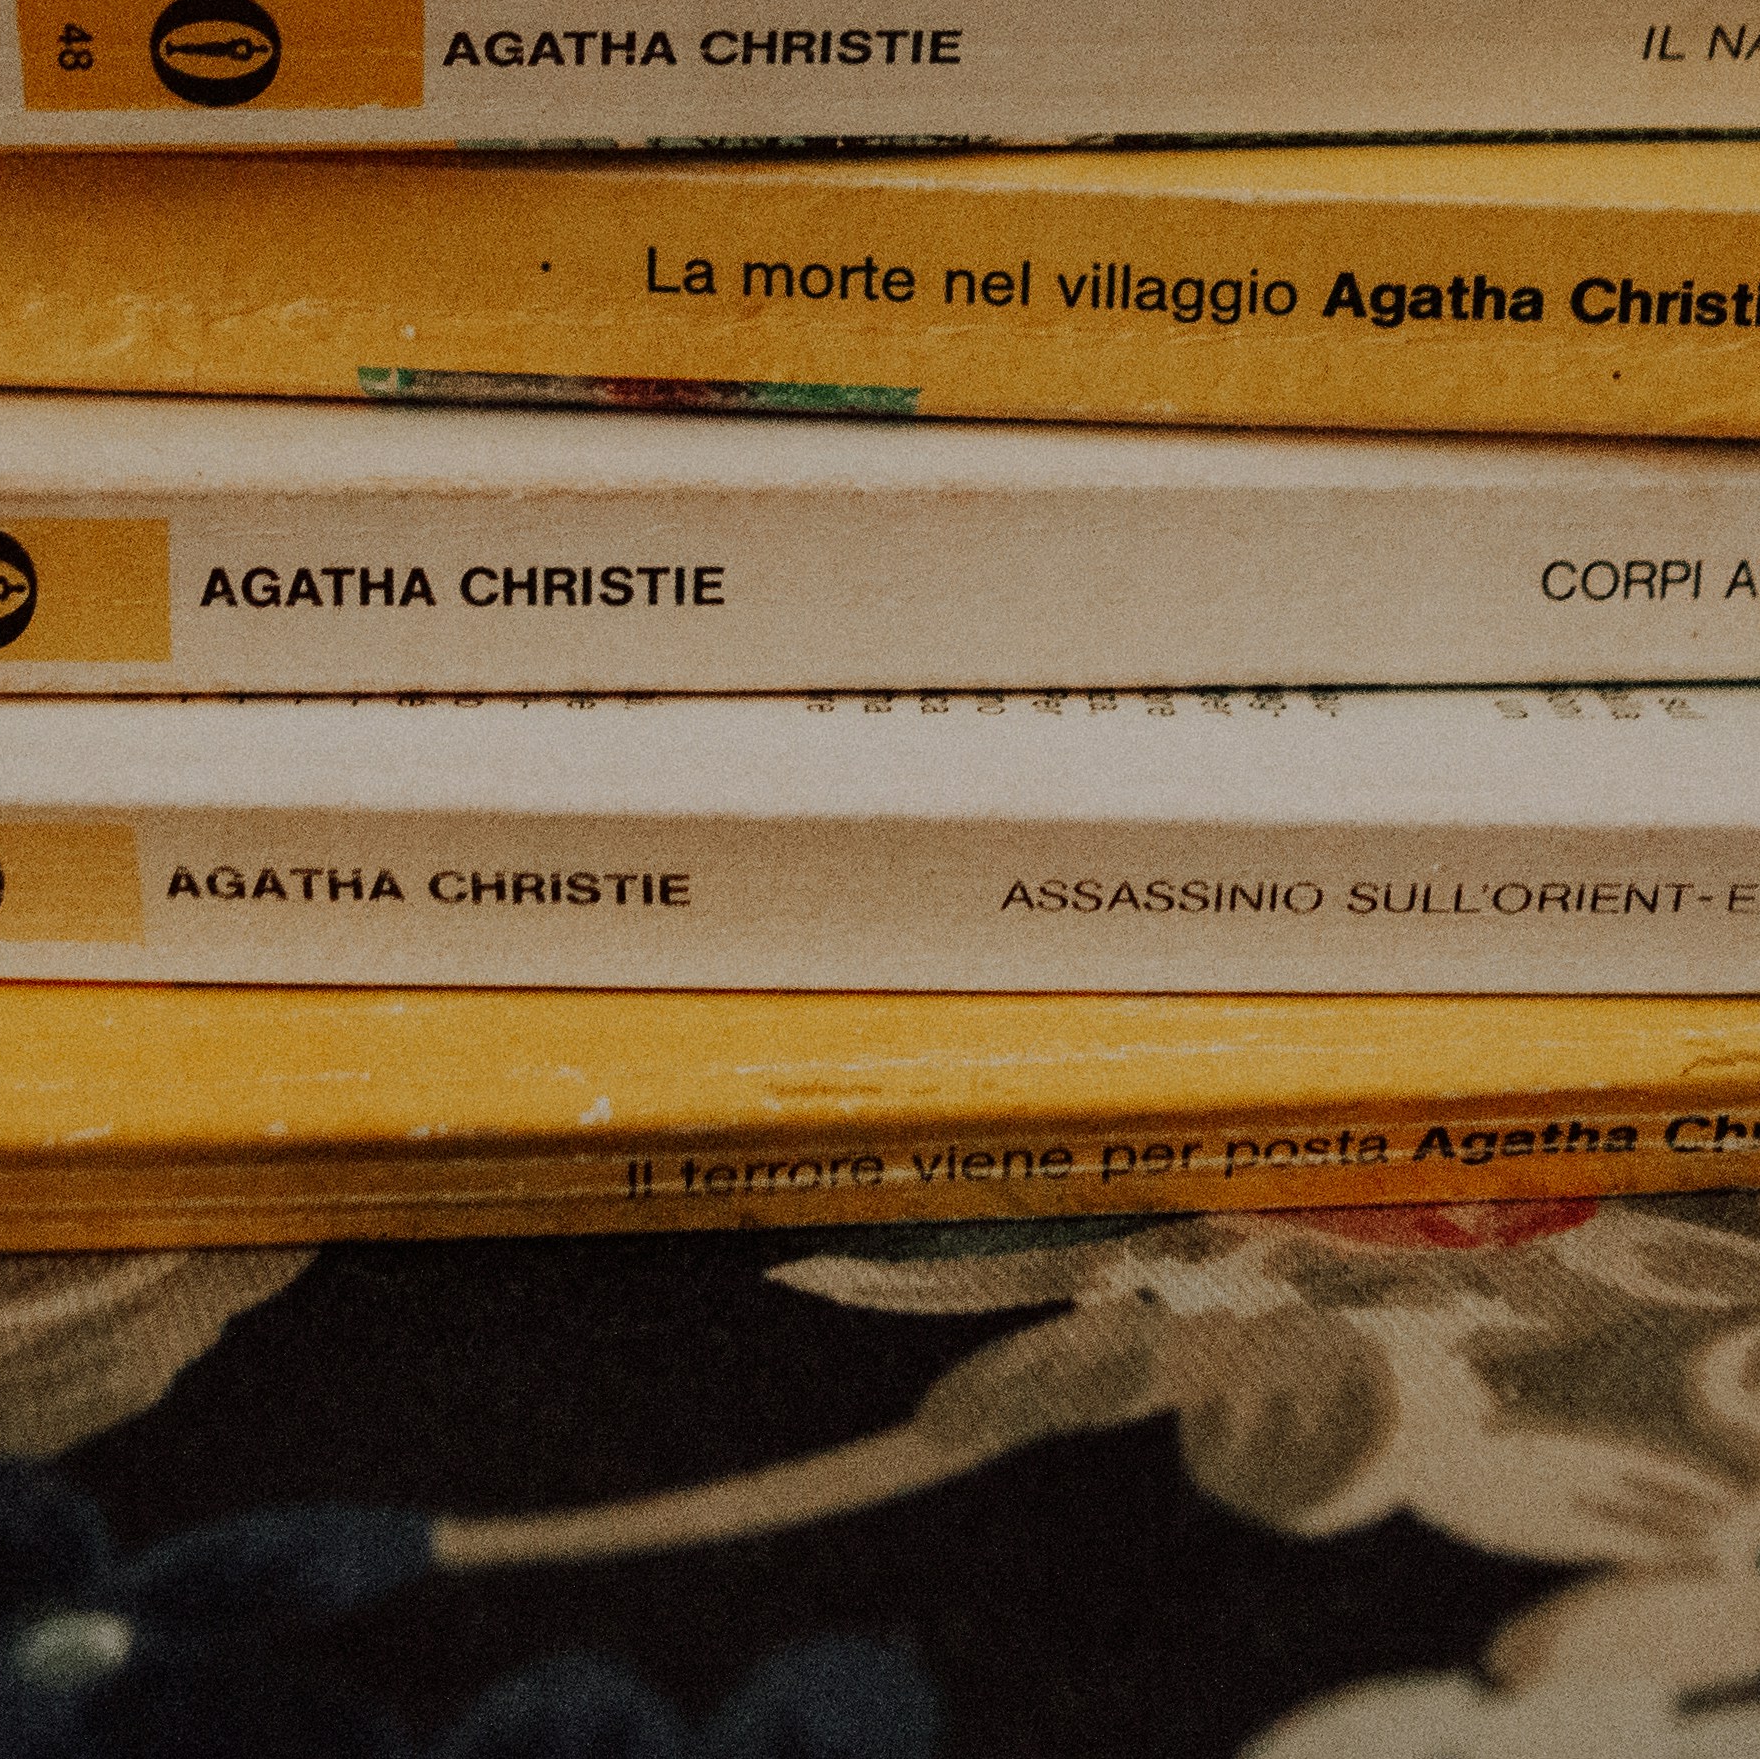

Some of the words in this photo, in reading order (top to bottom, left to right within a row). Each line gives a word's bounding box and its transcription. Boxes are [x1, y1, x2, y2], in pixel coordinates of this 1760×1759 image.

[57, 23, 94, 72] 48
[442, 30, 678, 67] AGATHA
[699, 28, 964, 67] CHRISTIE
[1642, 23, 1687, 62] IL
[646, 246, 717, 296] La
[742, 257, 917, 303] morte
[944, 260, 1032, 306] nel
[1057, 262, 1299, 325] villaggio
[1322, 270, 1544, 328] Agatha
[199, 566, 438, 608] AGATHA
[459, 565, 726, 608] CHRISTIE
[1541, 558, 1703, 602] CORPI
[166, 864, 406, 902] AGATHA
[427, 870, 692, 907] CHRISTIE
[1000, 878, 1324, 915] ASSASSINIO
[626, 1158, 653, 1200] Il
[679, 1149, 885, 1199] terrore
[912, 1139, 1075, 1186] viene
[1099, 1136, 1205, 1186] per
[1223, 1127, 1389, 1180] posta
[1411, 1119, 1639, 1165] Agatha
